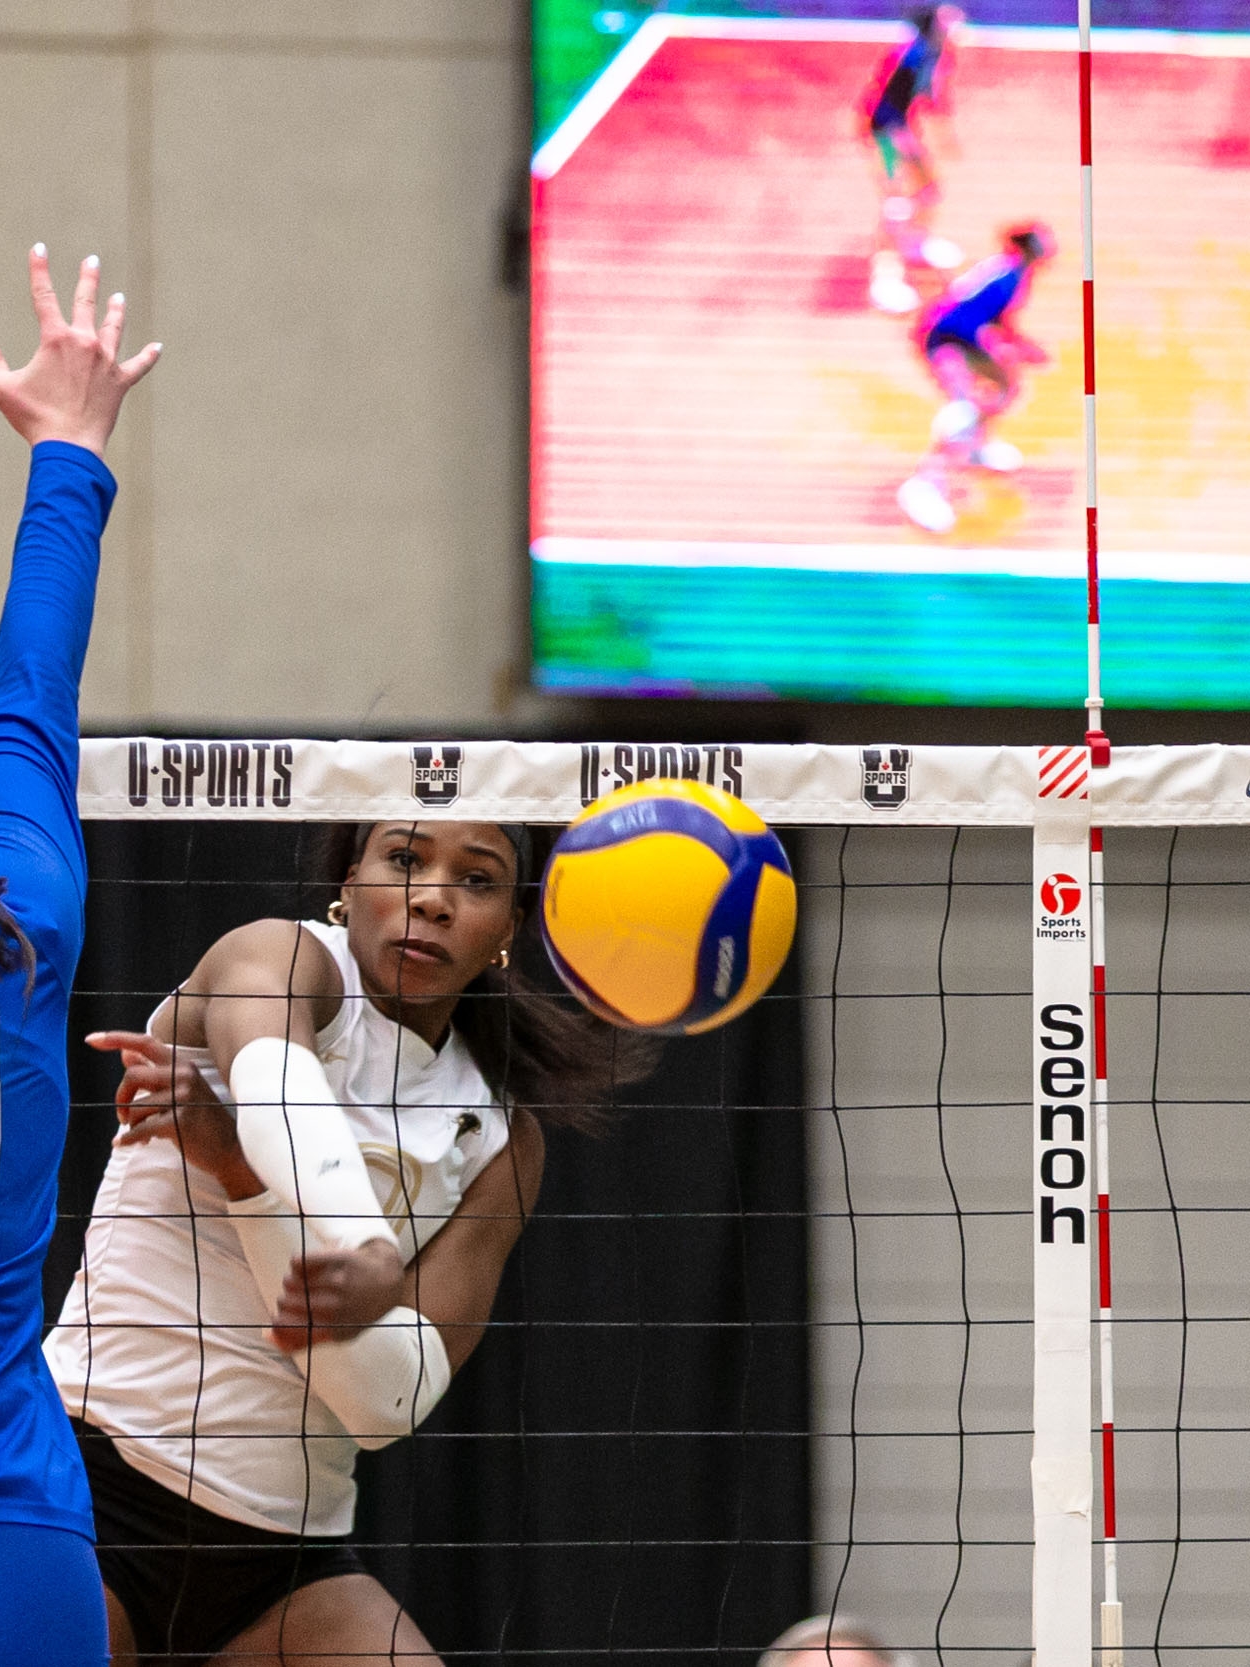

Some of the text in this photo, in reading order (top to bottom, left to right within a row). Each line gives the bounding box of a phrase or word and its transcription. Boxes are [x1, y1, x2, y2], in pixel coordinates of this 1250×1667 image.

[161, 743, 293, 808] SPORTS
[414, 769, 459, 782] SPORTS
[864, 772, 907, 785] SPORTS
[1040, 915, 1081, 929] Sports
[1036, 927, 1086, 940] Imports
[1040, 1003, 1086, 1244] Senoh
